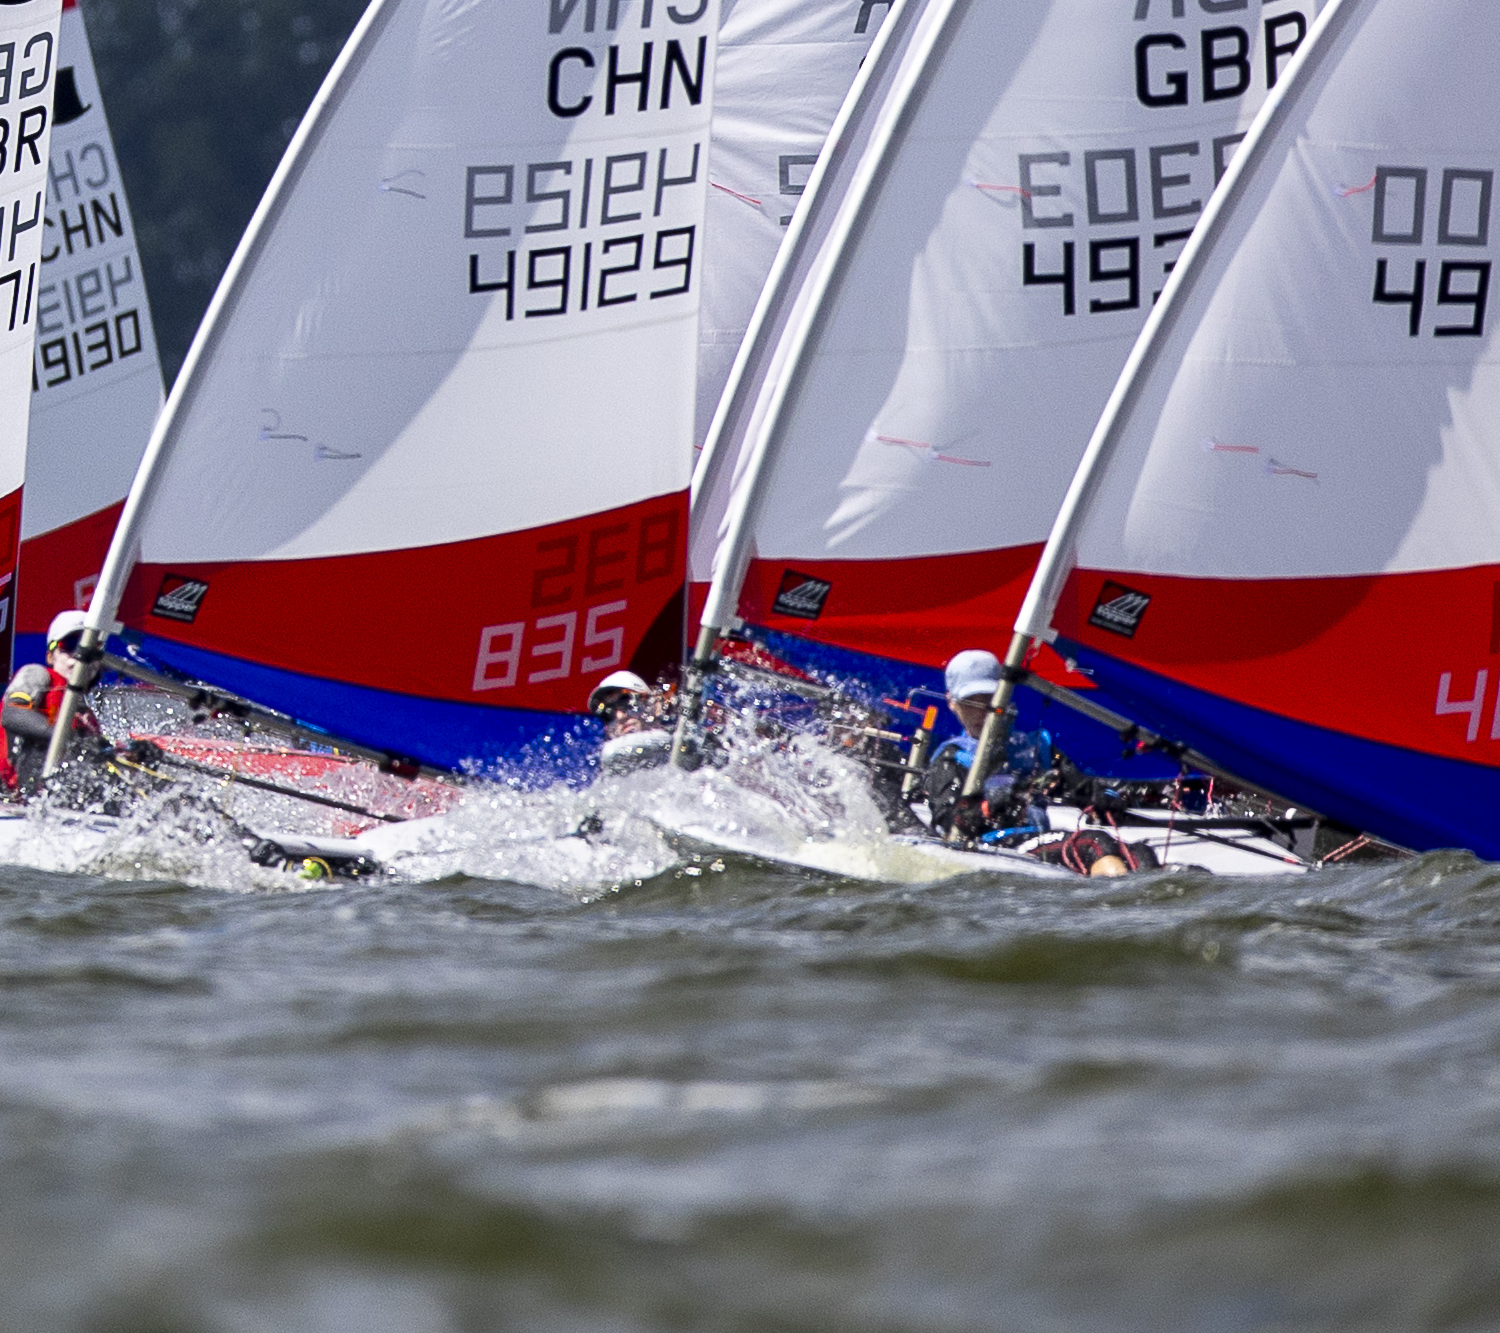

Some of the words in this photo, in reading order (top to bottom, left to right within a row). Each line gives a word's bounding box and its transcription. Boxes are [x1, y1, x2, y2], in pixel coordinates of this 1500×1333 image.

[547, 35, 708, 118] CHN
[469, 224, 696, 321] 49129
[32, 308, 142, 392] 9130
[472, 599, 628, 692] 835
[1435, 667, 1500, 744] 4
